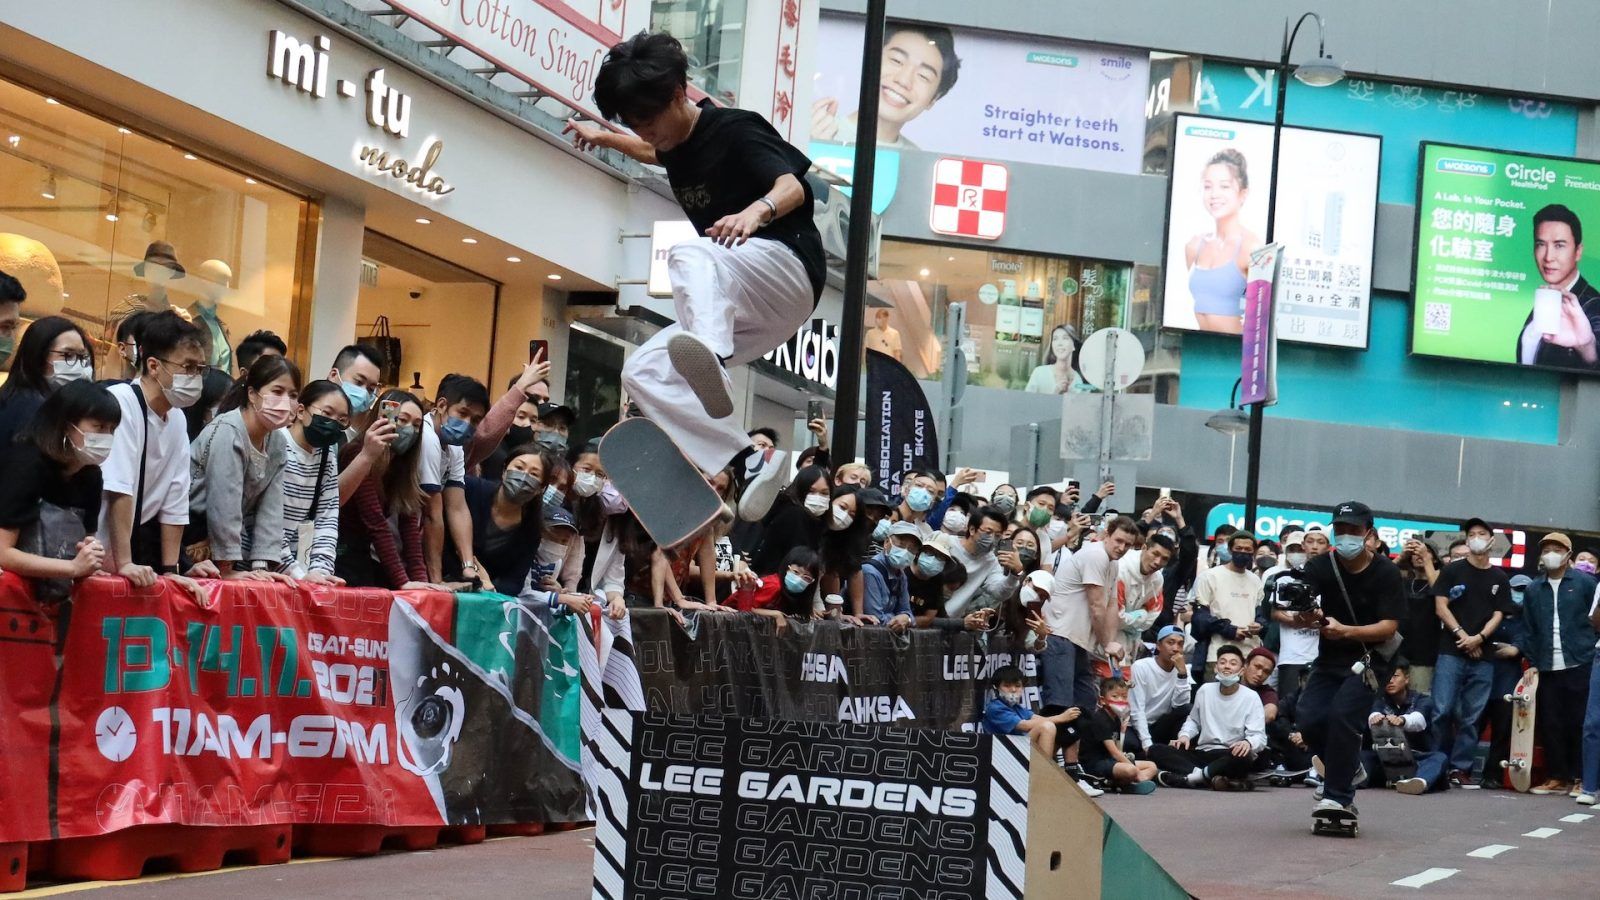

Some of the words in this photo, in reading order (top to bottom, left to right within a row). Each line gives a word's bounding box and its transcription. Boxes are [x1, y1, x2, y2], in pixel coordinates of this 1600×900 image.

[1033, 55, 1072, 65] watsons
[1100, 57, 1132, 69] smile
[984, 104, 1071, 127] Straighter
[1076, 116, 1118, 133] teeth
[983, 125, 1023, 140] start
[1028, 130, 1045, 143] at
[1049, 130, 1125, 152] Watsons.
[358, 140, 455, 197] moda
[1444, 160, 1489, 173] watsons
[1505, 163, 1556, 183] Circle
[1434, 192, 1442, 200] A
[1495, 198, 1526, 210] Pocket.
[1430, 207, 1516, 237] 您的隨身
[1429, 235, 1493, 262] 化驗室
[880, 391, 891, 490] ASSOCIATION
[915, 409, 924, 456] SKATE
[903, 443, 912, 473] OUP
[943, 654, 970, 680] LEE
[311, 660, 388, 708] 2021
[153, 706, 390, 765] 11AM-6PM
[641, 731, 727, 763] LEE
[737, 738, 979, 784] GARDENS
[639, 762, 725, 795] LEE
[737, 771, 978, 818] GARDENS
[637, 794, 723, 828] LEE
[735, 804, 976, 850] GARDENS
[635, 827, 721, 862] LEE
[734, 837, 975, 886] GARDENS
[634, 860, 720, 896] LEE
